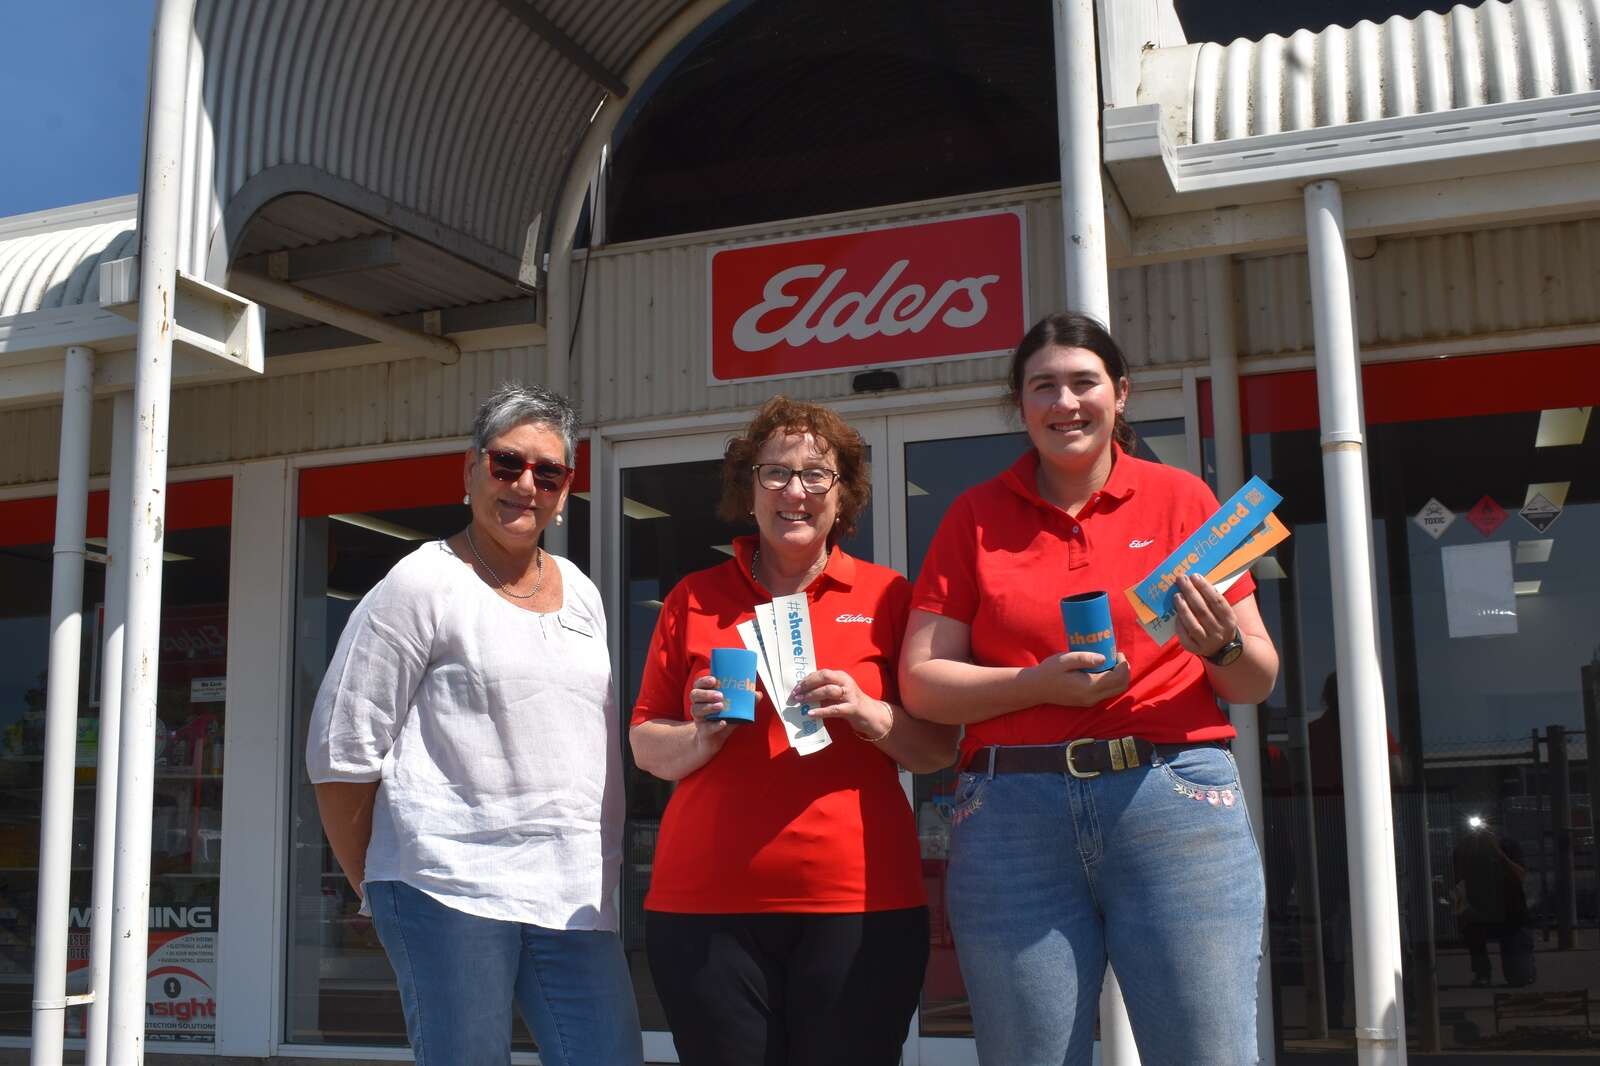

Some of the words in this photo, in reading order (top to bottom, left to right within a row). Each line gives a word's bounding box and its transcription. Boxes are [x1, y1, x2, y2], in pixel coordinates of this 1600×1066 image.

[732, 259, 1000, 352] Elders
[835, 613, 875, 624] Elders
[1069, 628, 1111, 645] share
[69, 906, 212, 928] WING
[145, 998, 216, 1021] nsight
